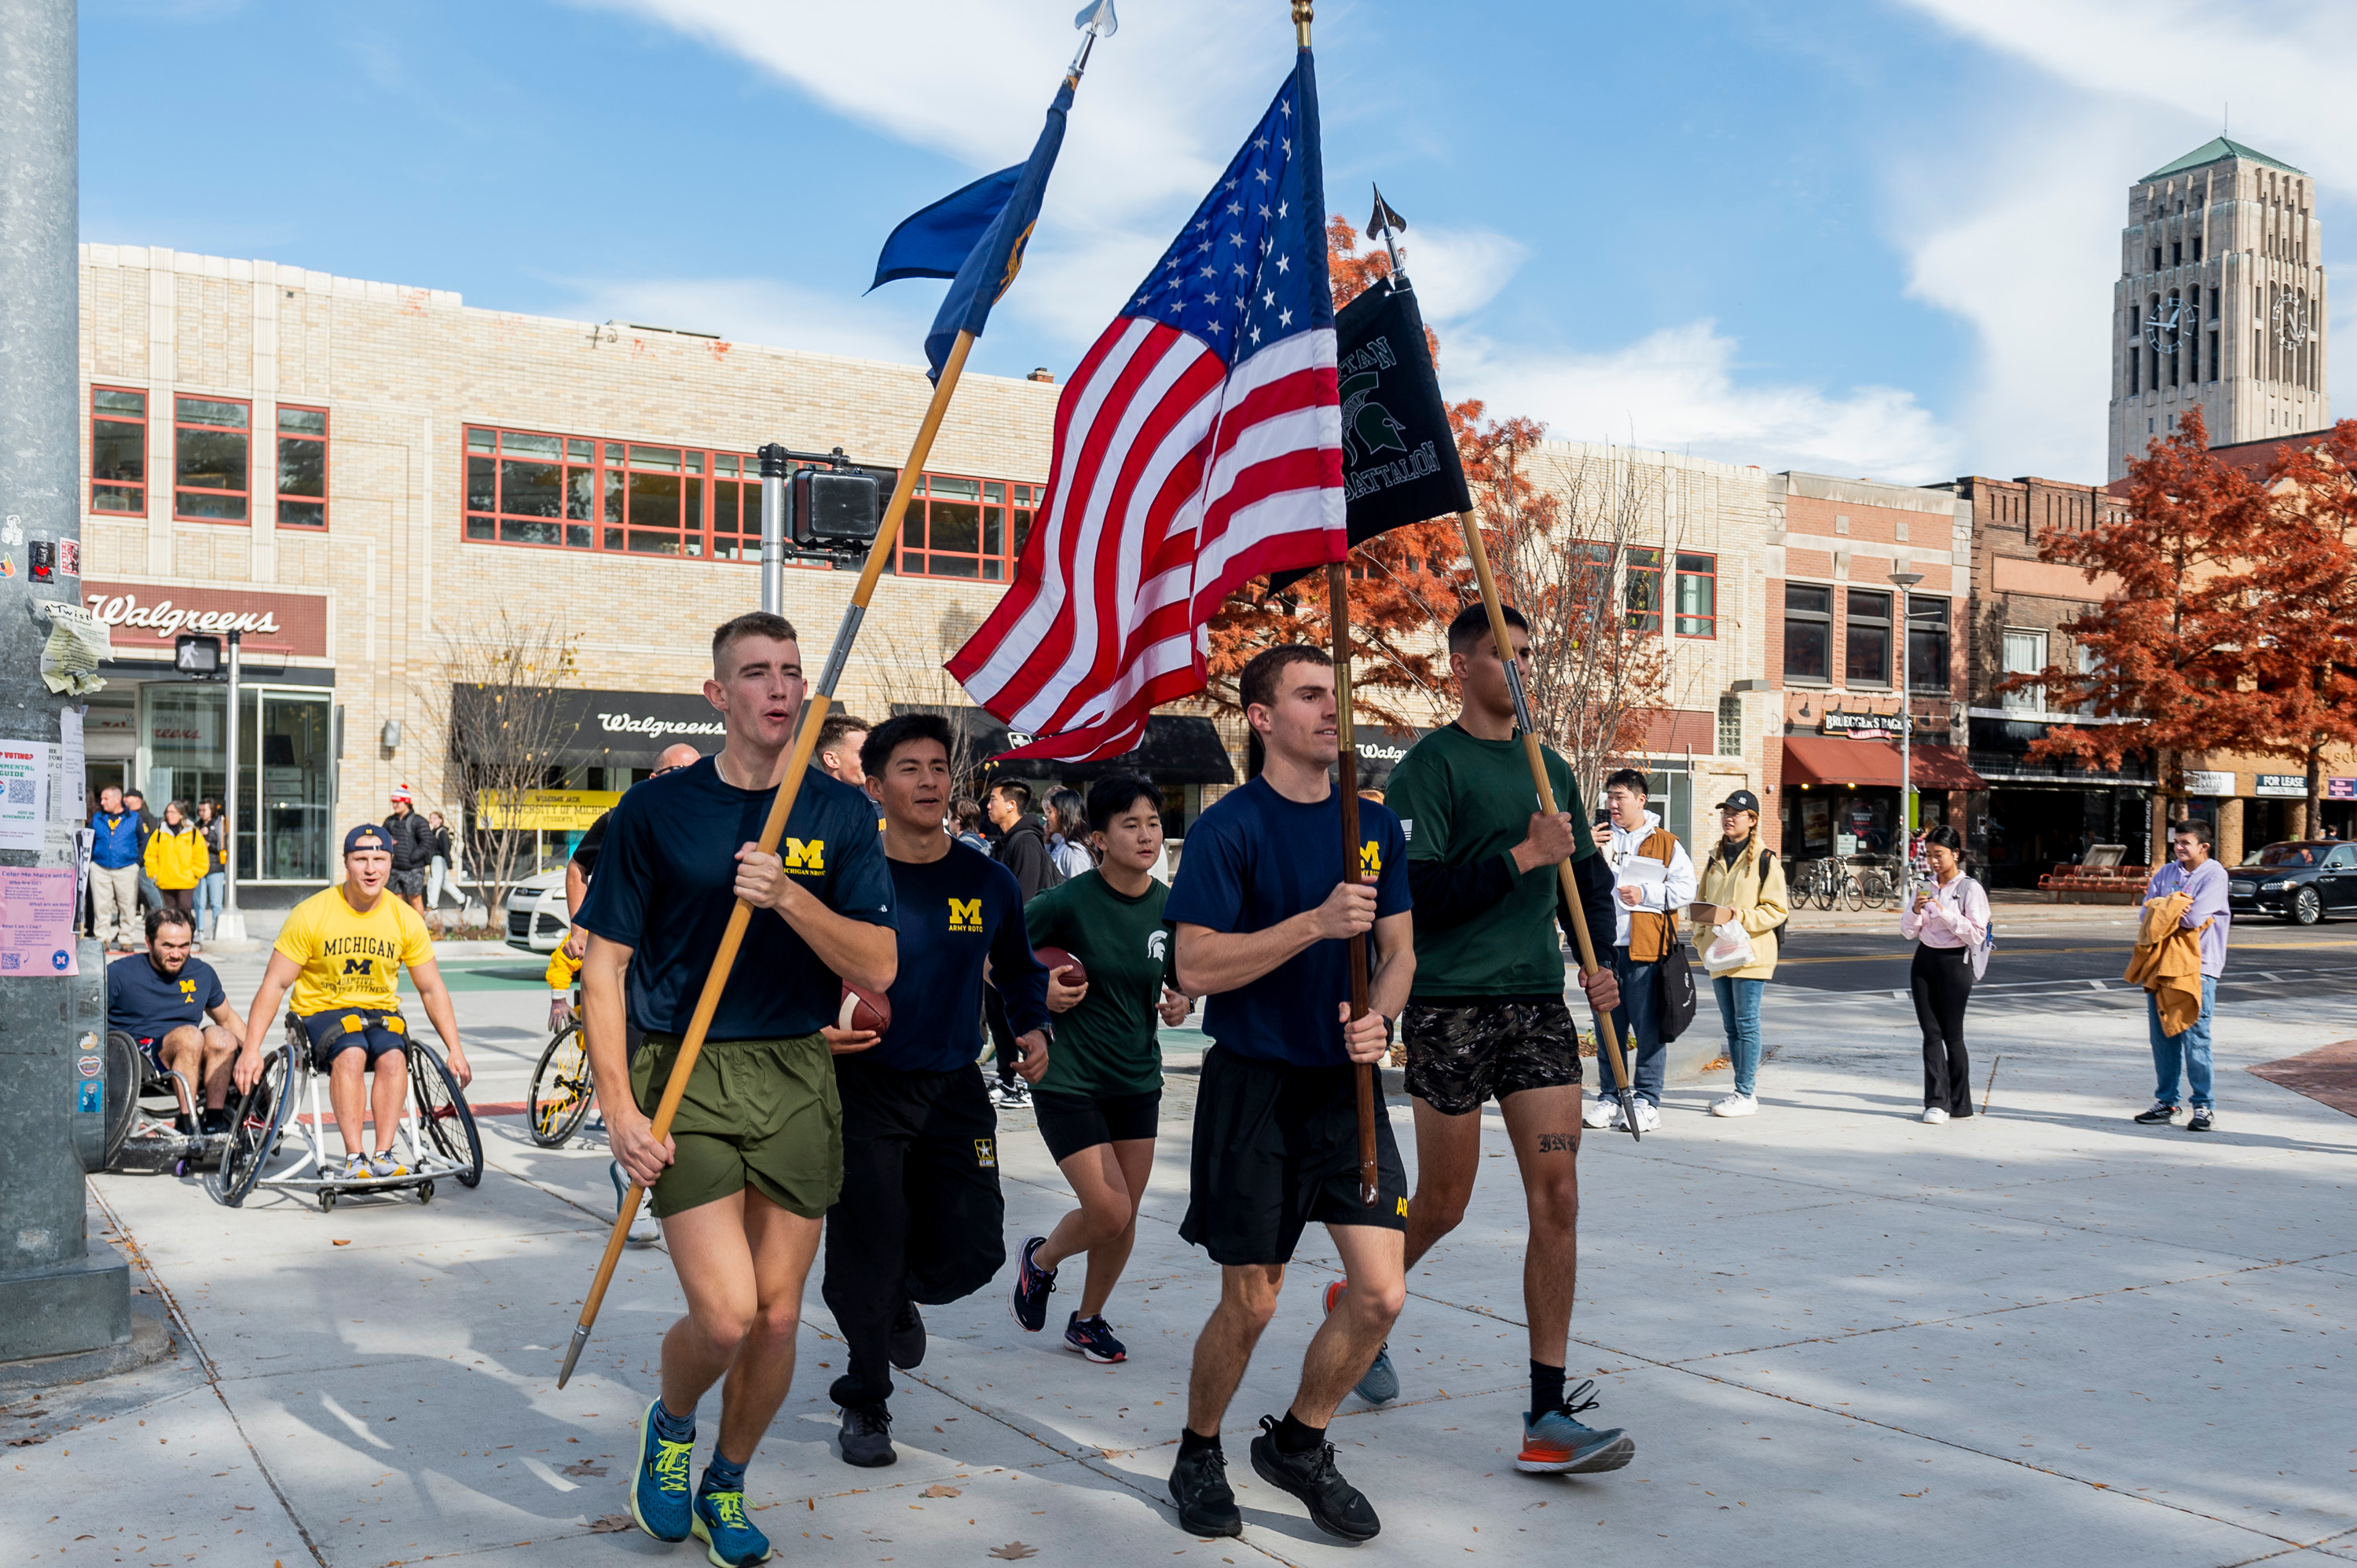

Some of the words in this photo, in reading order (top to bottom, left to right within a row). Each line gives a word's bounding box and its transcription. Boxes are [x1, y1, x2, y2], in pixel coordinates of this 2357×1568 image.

[1343, 441, 1440, 503] BATTALION
[51, 604, 90, 621] Twist
[87, 594, 280, 638] Walgreens
[597, 713, 728, 739] Walgreens
[1881, 717, 1913, 733] BAGES
[4, 752, 34, 760] VOTING?
[2264, 775, 2280, 786] FOR
[2281, 776, 2304, 787] LEASE
[560, 804, 571, 815] OF
[574, 805, 611, 815] MICHIG
[786, 837, 823, 869] M
[948, 898, 982, 925] M
[324, 936, 395, 959] MICHIGAN
[343, 959, 372, 975] M
[321, 981, 346, 994] SPORTS
[336, 976, 374, 985] ADAPTIVE
